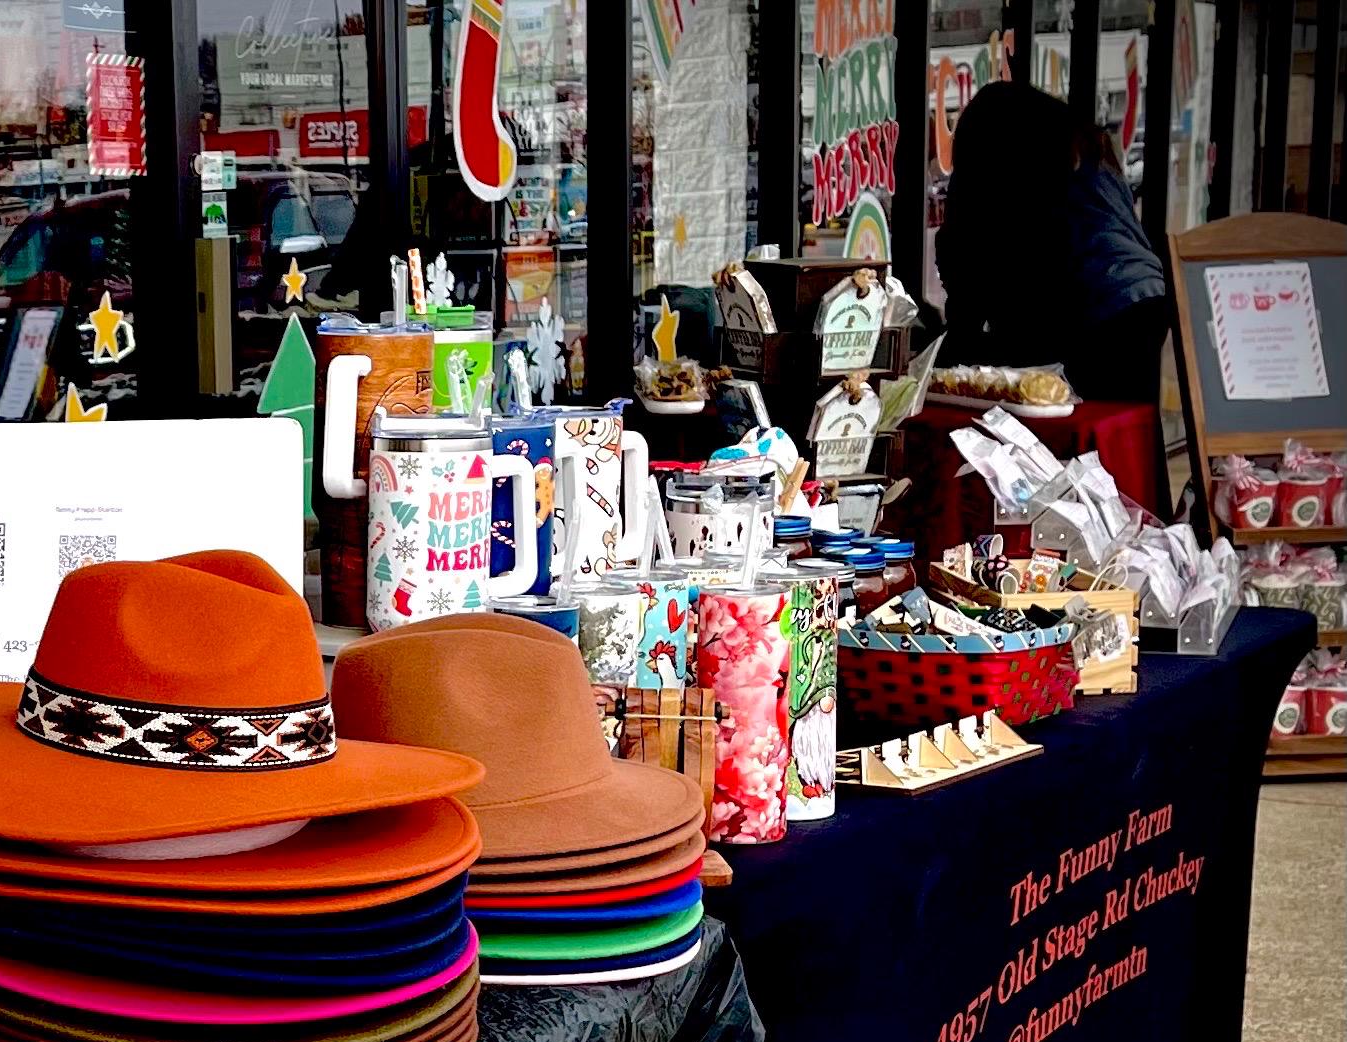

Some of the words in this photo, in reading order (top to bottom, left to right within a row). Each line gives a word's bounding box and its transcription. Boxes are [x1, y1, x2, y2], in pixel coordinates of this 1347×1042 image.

[240, 72, 260, 86] YOUR
[812, 35, 896, 147] MERRY
[812, 120, 899, 226] MERRY
[1010, 871, 1051, 926] The
[1055, 829, 1123, 894] Funny
[1124, 804, 1173, 852] Farm
[997, 937, 1039, 1005] Old
[1042, 910, 1099, 972] Stage
[1102, 879, 1131, 931] Rd
[1134, 851, 1205, 912] Chuckey
